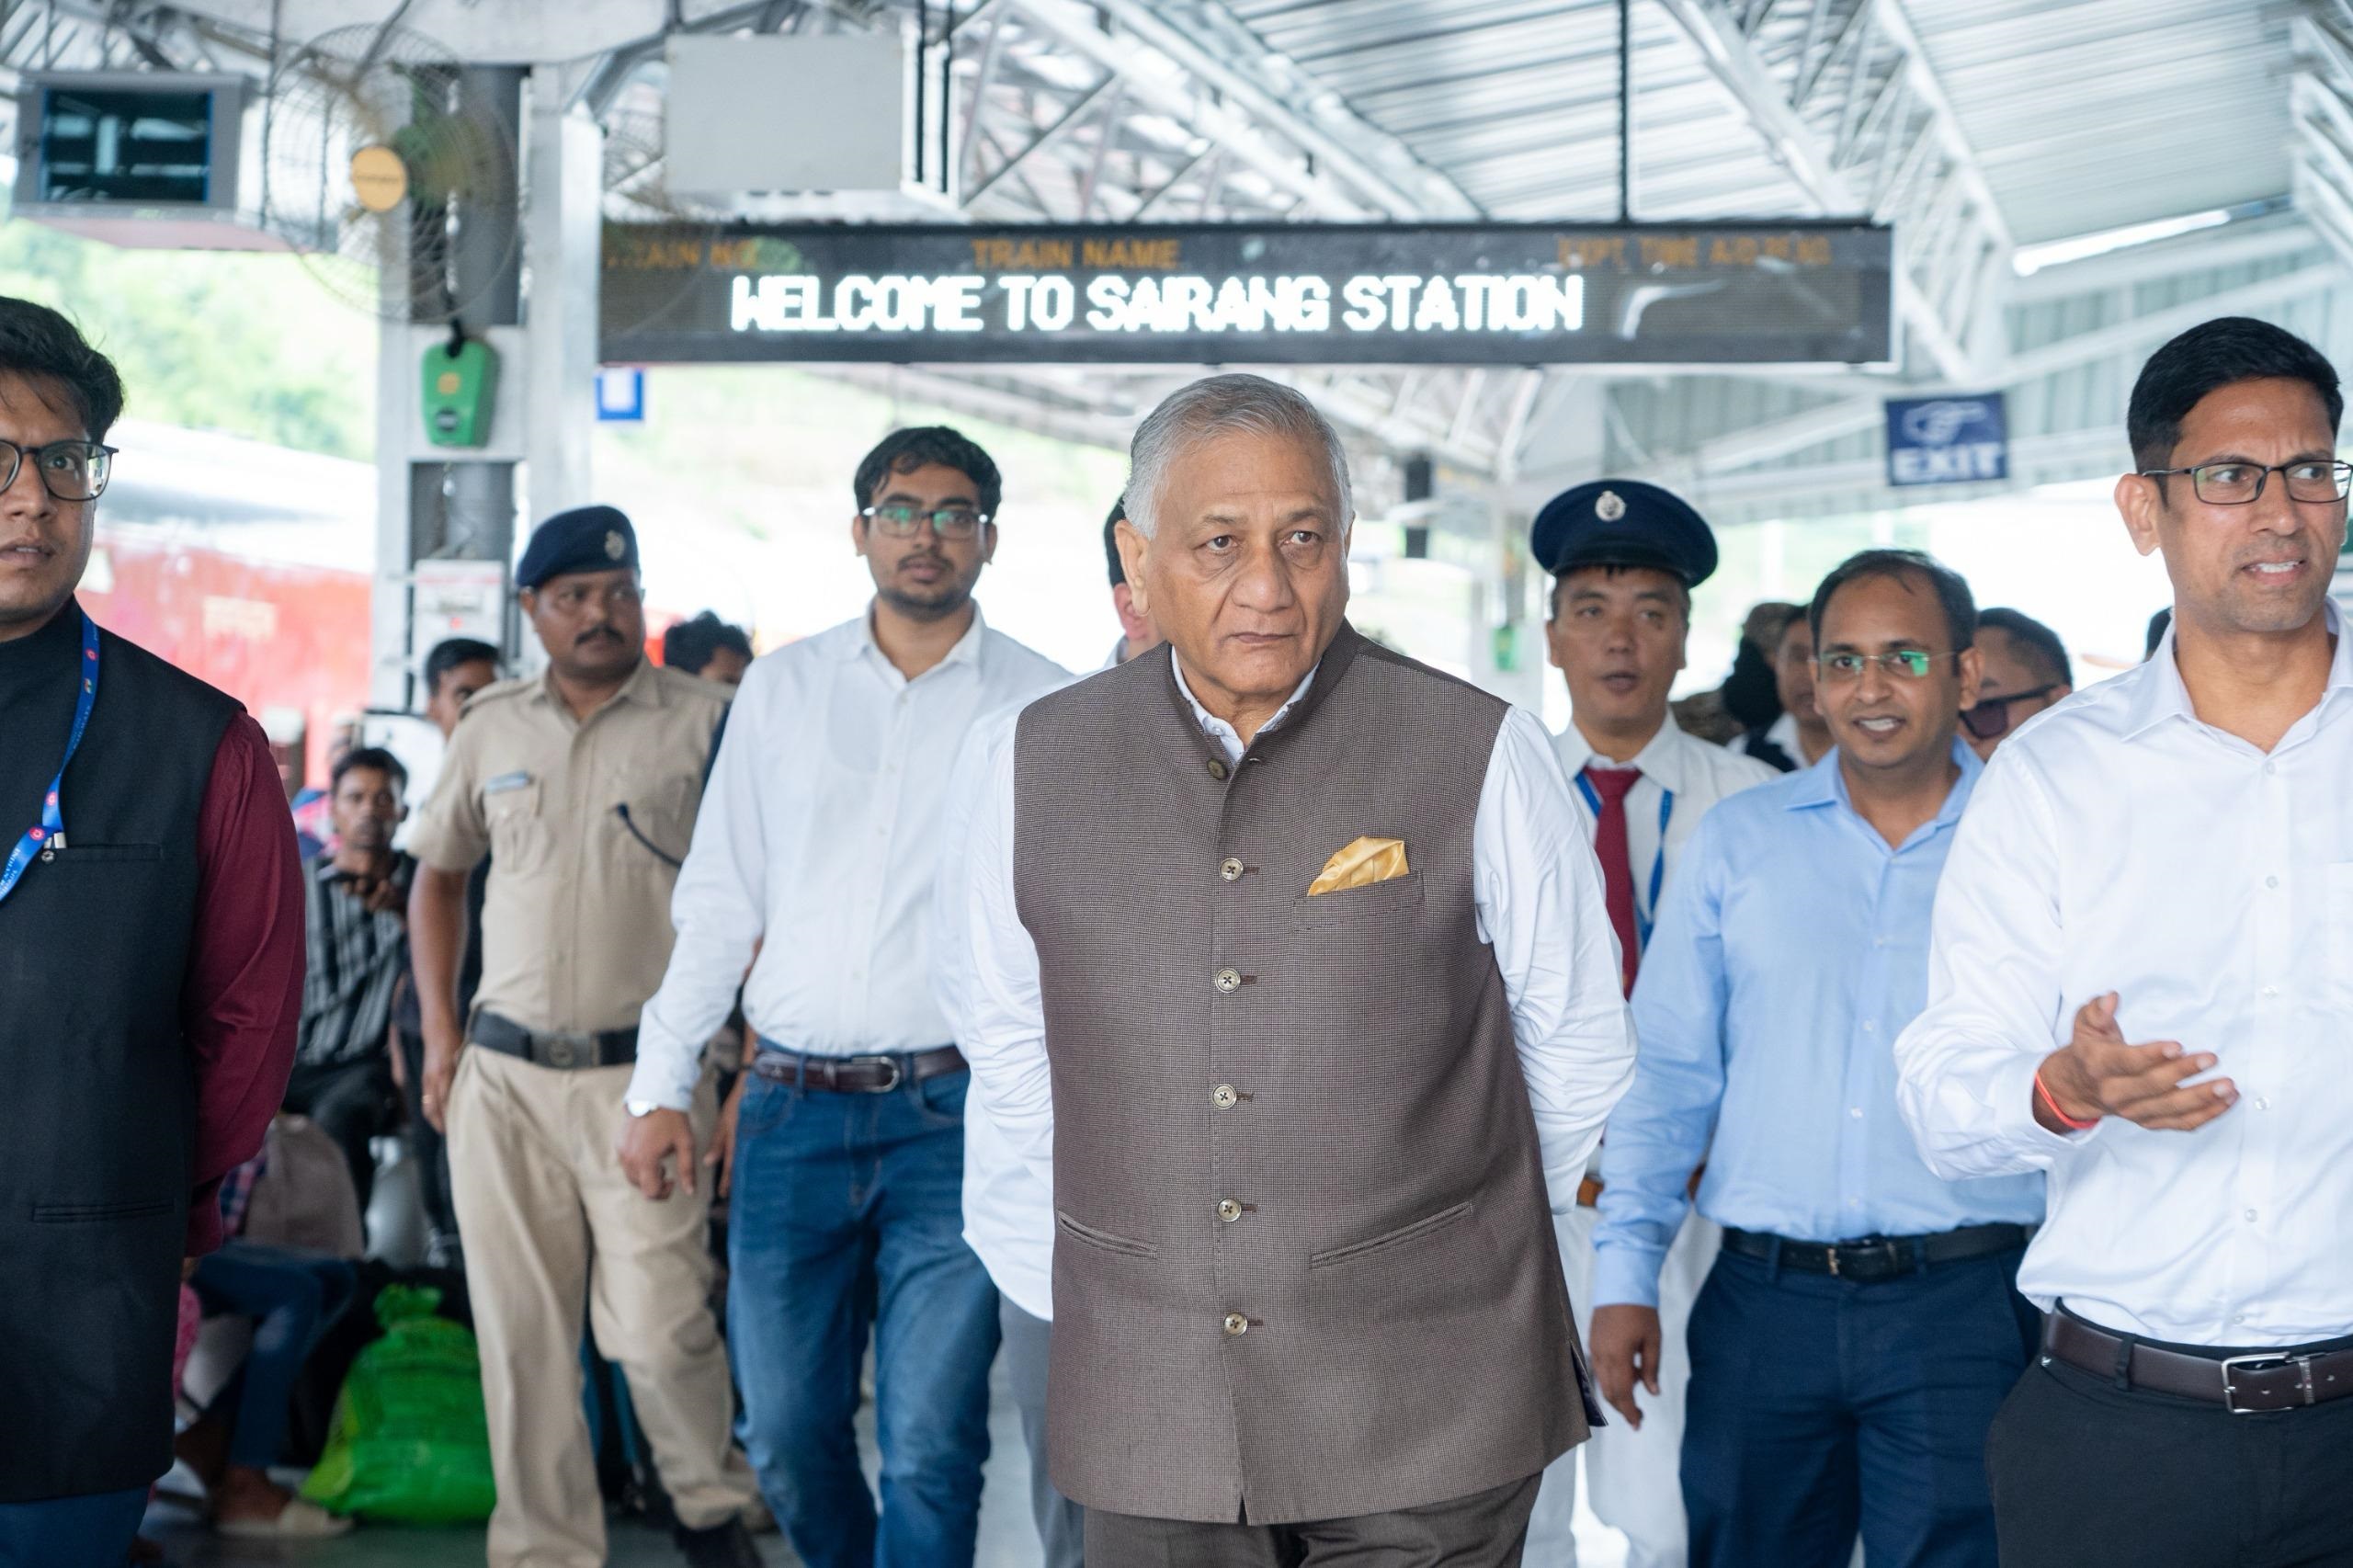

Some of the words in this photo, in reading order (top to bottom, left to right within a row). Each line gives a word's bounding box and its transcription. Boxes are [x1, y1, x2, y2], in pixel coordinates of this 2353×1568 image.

[971, 237, 1074, 270] TRAIN
[1082, 237, 1178, 270] NAME
[731, 275, 986, 332] WELCOME
[998, 275, 1074, 332] TO
[1086, 275, 1331, 332] SAIRANG
[1342, 275, 1584, 332] STATION
[1893, 443, 2001, 481] EXIT
